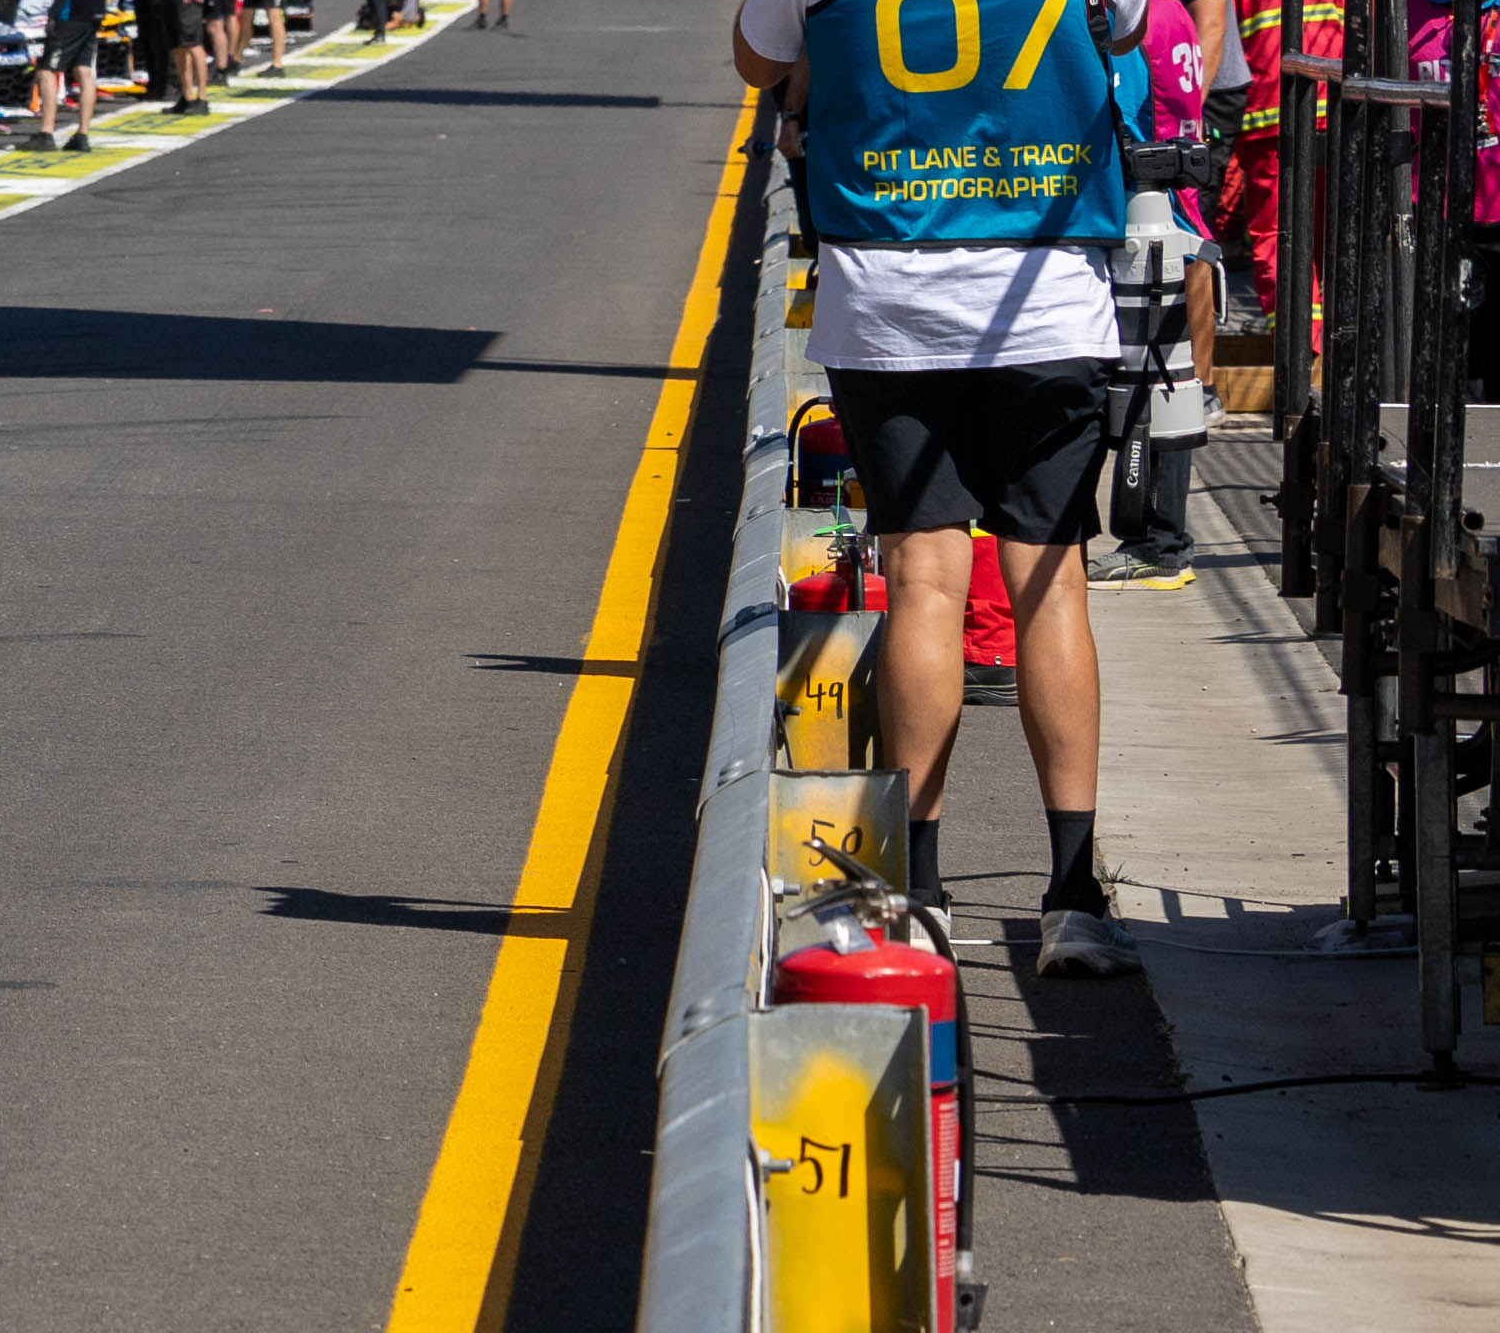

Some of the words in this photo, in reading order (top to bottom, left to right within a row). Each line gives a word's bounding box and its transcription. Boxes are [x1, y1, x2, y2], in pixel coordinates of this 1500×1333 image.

[863, 149, 904, 171] PIT
[910, 148, 976, 170] LANE
[983, 147, 1002, 167] &
[1010, 143, 1093, 167] TRACK
[874, 173, 1079, 203] PHOTOGRAPHER
[1124, 436, 1145, 489] Canon
[805, 673, 844, 721] 49
[809, 816, 863, 859] 50
[798, 1135, 852, 1200] 51
